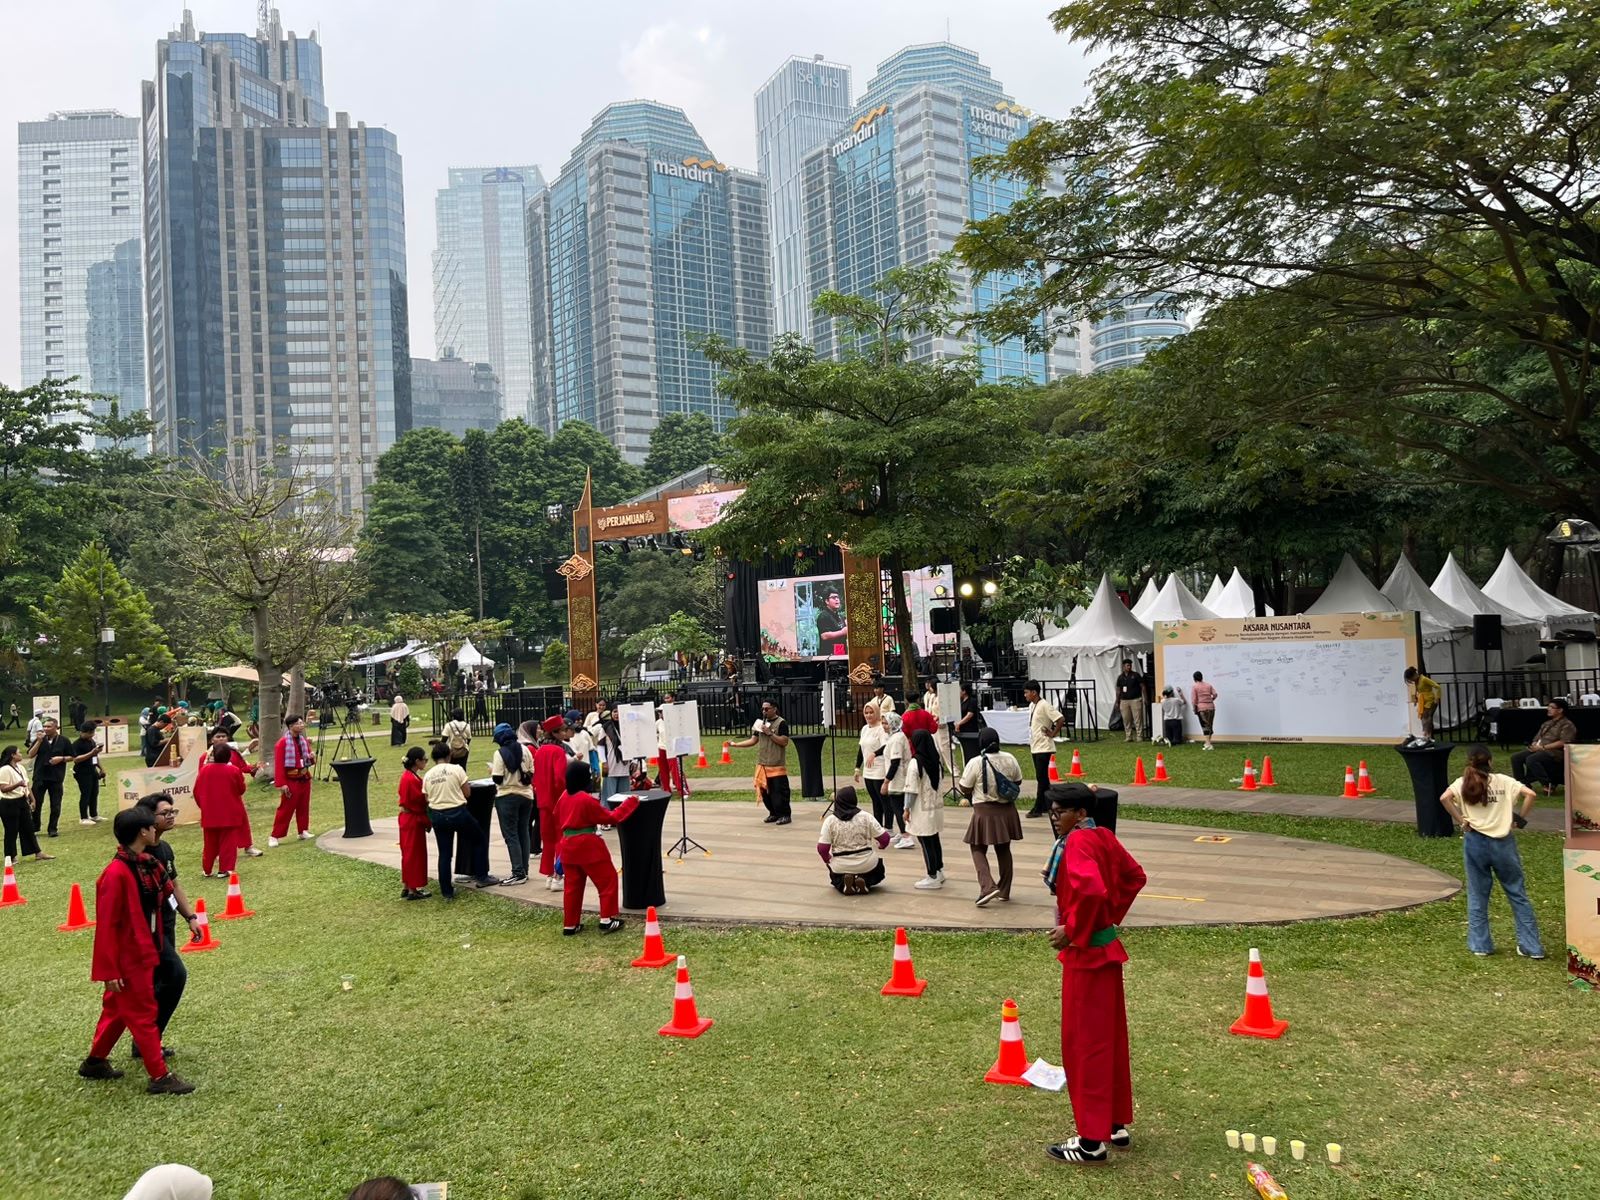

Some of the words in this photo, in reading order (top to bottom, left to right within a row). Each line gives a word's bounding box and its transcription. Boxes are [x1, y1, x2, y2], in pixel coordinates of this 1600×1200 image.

[798, 67, 839, 89] Sequis
[970, 105, 1020, 129] mandiri
[832, 122, 876, 157] mandiri
[653, 160, 712, 184] mandiri
[606, 512, 645, 527] PERJAMUAN
[1243, 623, 1269, 632] AKSARA
[1270, 621, 1311, 631] NUSANTARA
[162, 785, 191, 796] KETAPEL
